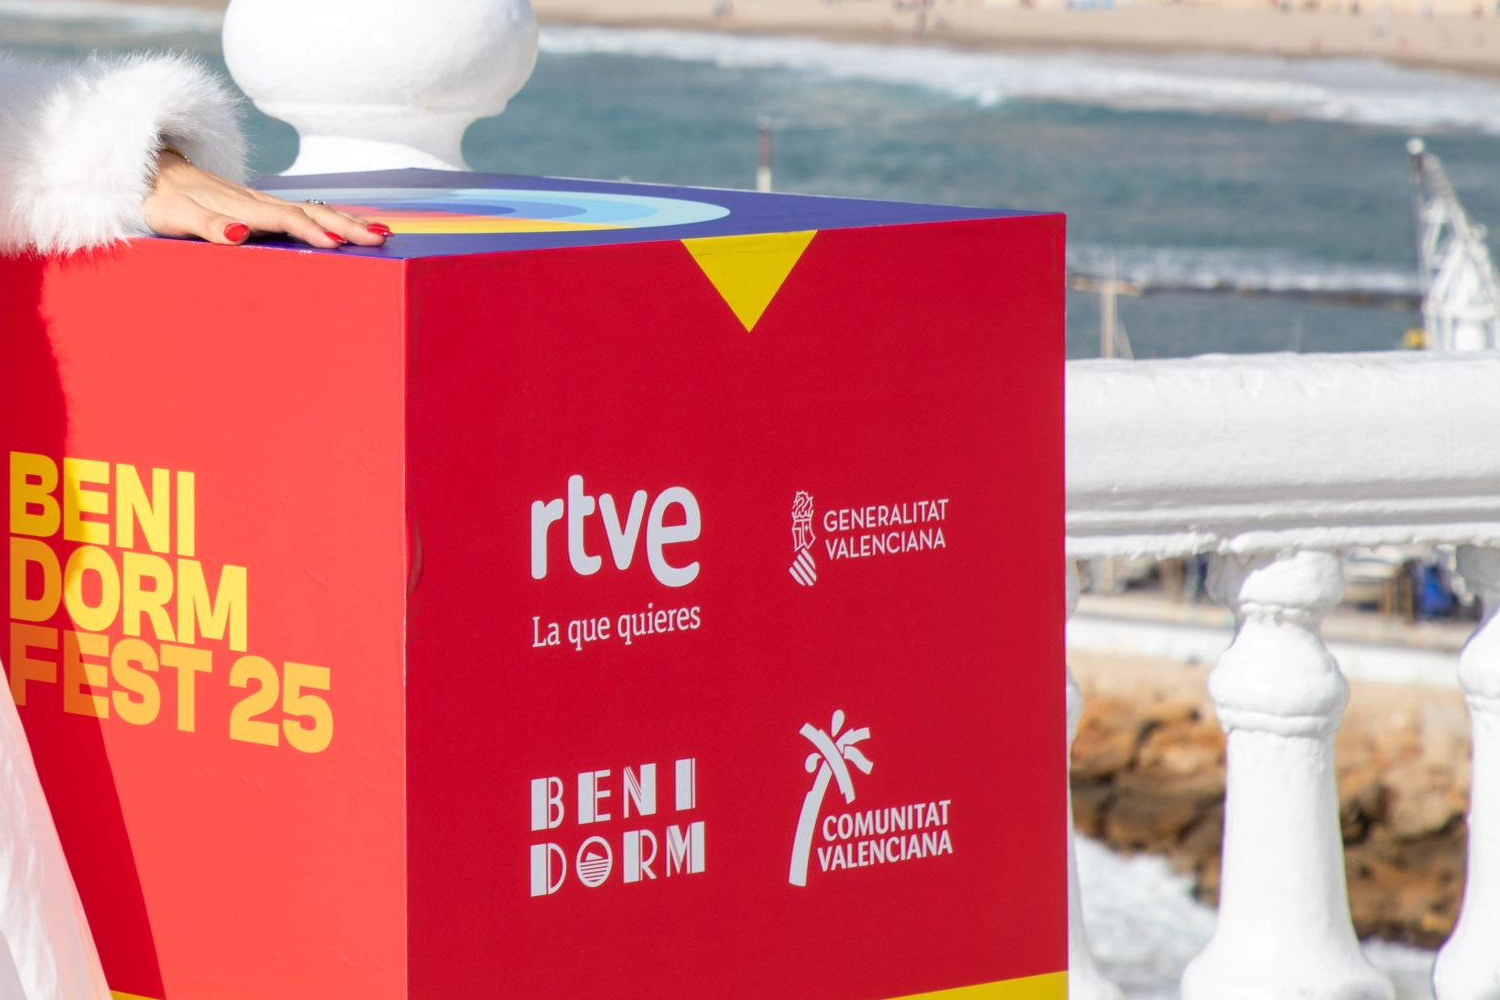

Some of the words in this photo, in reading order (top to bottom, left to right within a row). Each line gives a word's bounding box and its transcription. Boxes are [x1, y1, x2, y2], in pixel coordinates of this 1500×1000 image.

[9, 451, 196, 558] BENI
[530, 474, 702, 588] rtve
[823, 498, 949, 533] GENERALITAT
[825, 527, 947, 561] VALENCIANA
[9, 536, 248, 653] DORM
[532, 615, 561, 648] La
[567, 616, 611, 652] que
[617, 602, 701, 646] quieres
[9, 621, 213, 734] FEST
[228, 654, 334, 755] 25
[530, 757, 697, 832] BENI
[822, 799, 952, 842] COMUNITAT
[530, 820, 706, 898] DORM
[817, 829, 954, 873] VALENCIANA
